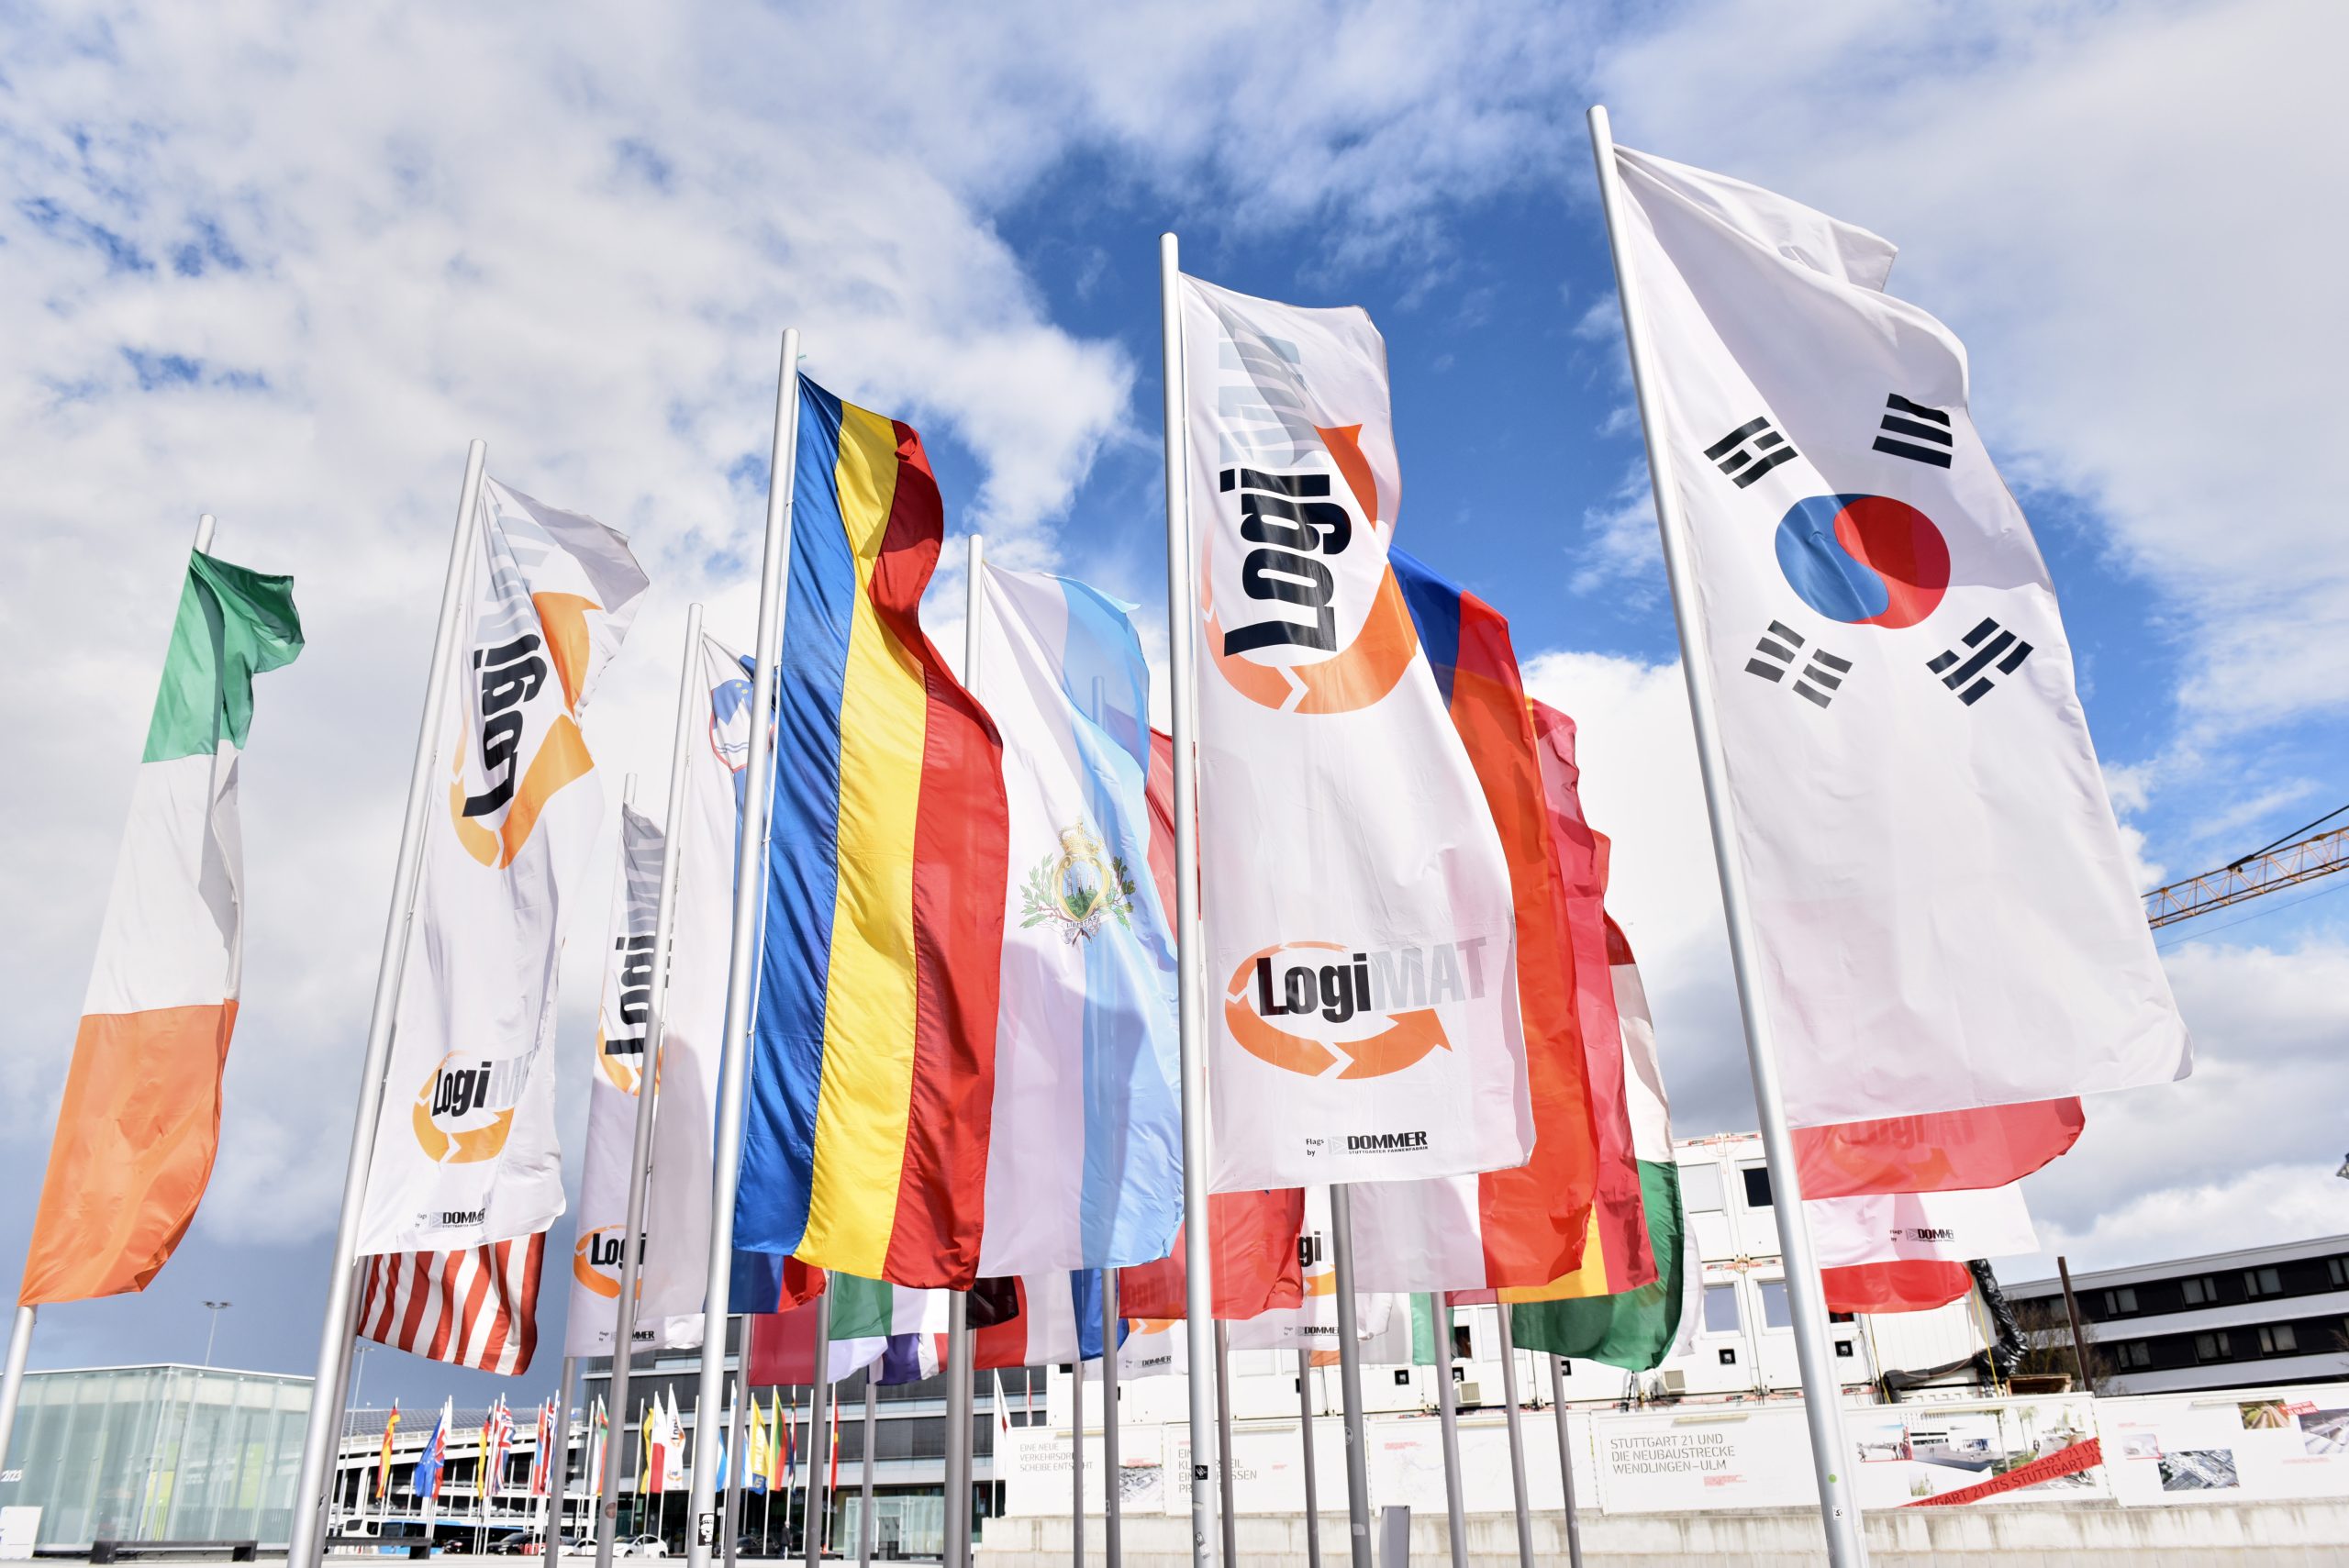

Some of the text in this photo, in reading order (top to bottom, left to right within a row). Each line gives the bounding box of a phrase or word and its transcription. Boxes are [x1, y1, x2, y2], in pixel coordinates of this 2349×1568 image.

[1256, 936, 1486, 1024] LogiMAT
[1306, 1131, 1428, 1151] Flags DOMMER
[1307, 1149, 1316, 1157] by
[1610, 1433, 1723, 1450] STUTTGART 21 UND
[1611, 1445, 1736, 1462] DIE NEUBAUSTRECKE
[1973, 1486, 1986, 1499] 21
[1989, 1480, 2009, 1494] ITS
[2011, 1456, 2086, 1487] STUTTGART
